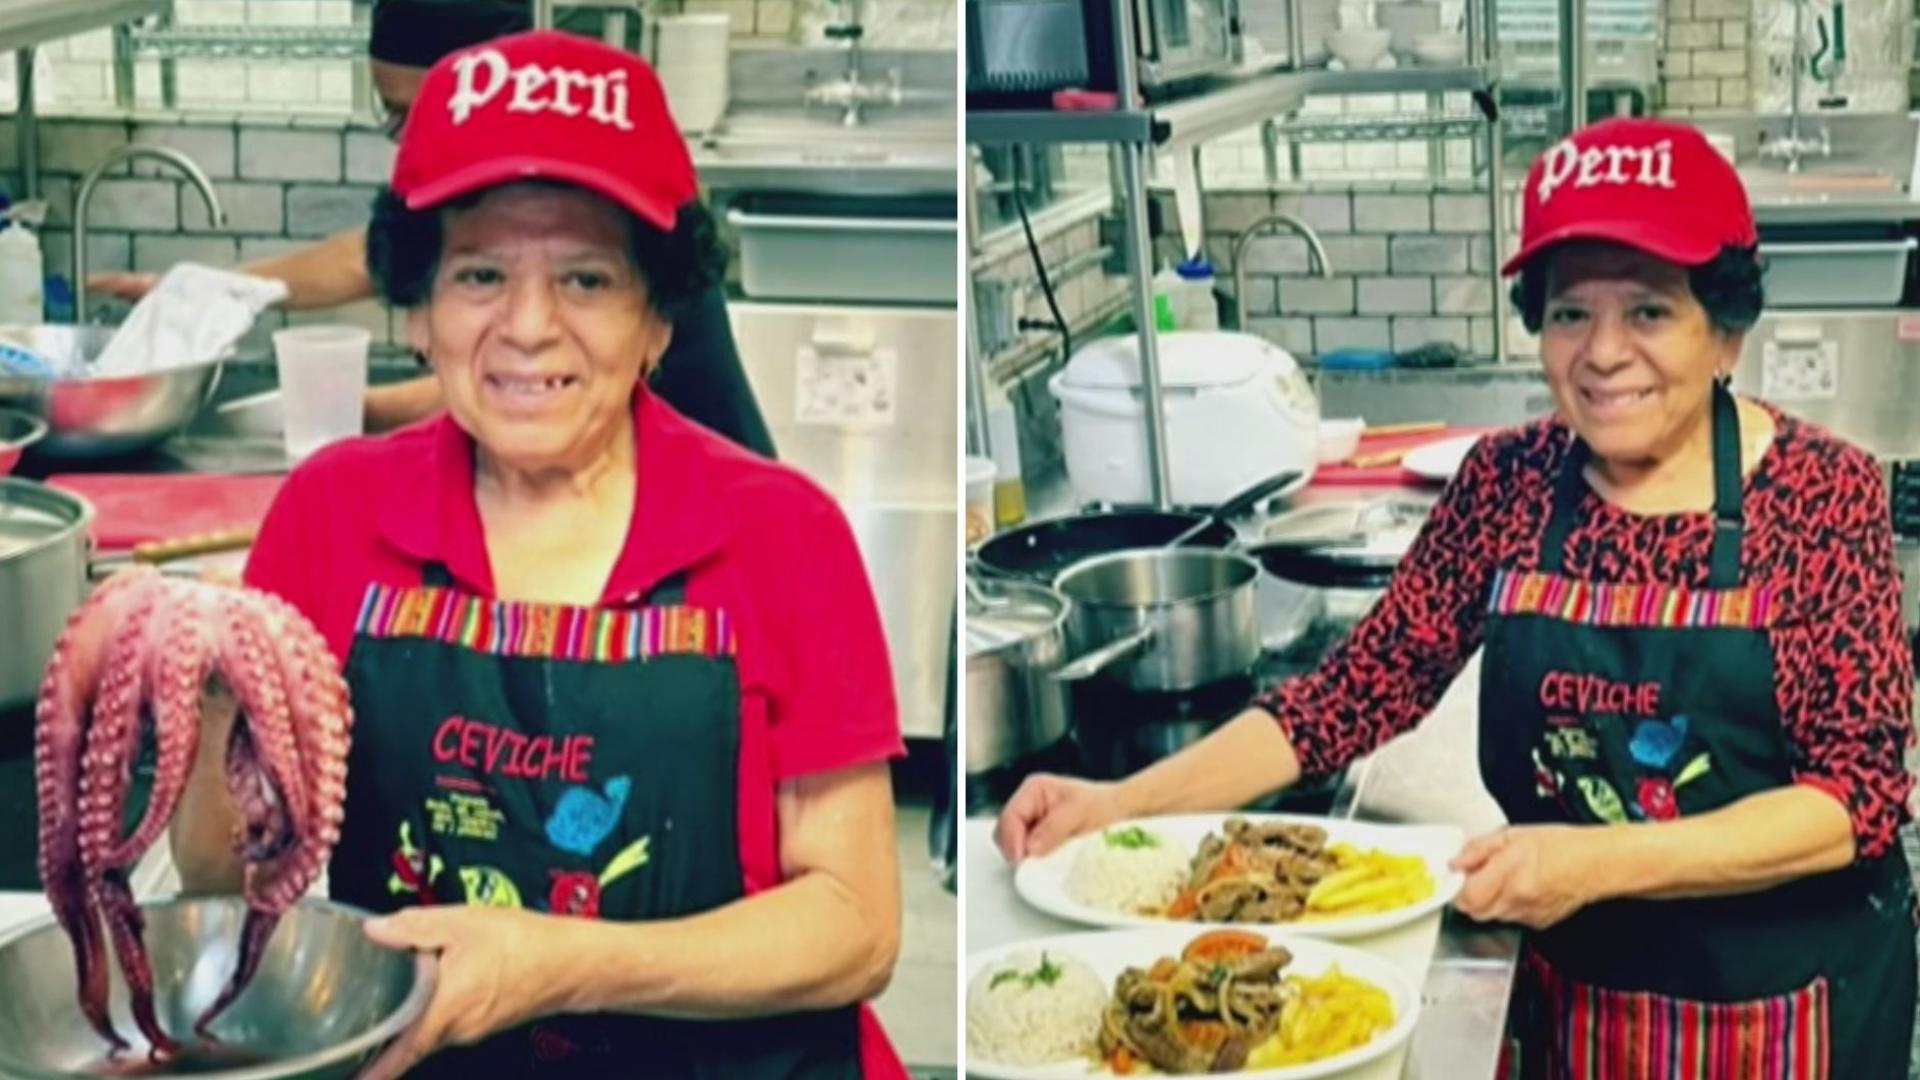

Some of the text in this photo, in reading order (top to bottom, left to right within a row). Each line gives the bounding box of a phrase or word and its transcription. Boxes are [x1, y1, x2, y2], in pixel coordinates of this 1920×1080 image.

[447, 49, 634, 130] Perú
[1538, 138, 1676, 204] Perú
[1540, 670, 1661, 715] CEVICHE
[432, 715, 594, 781] CEVICHE
